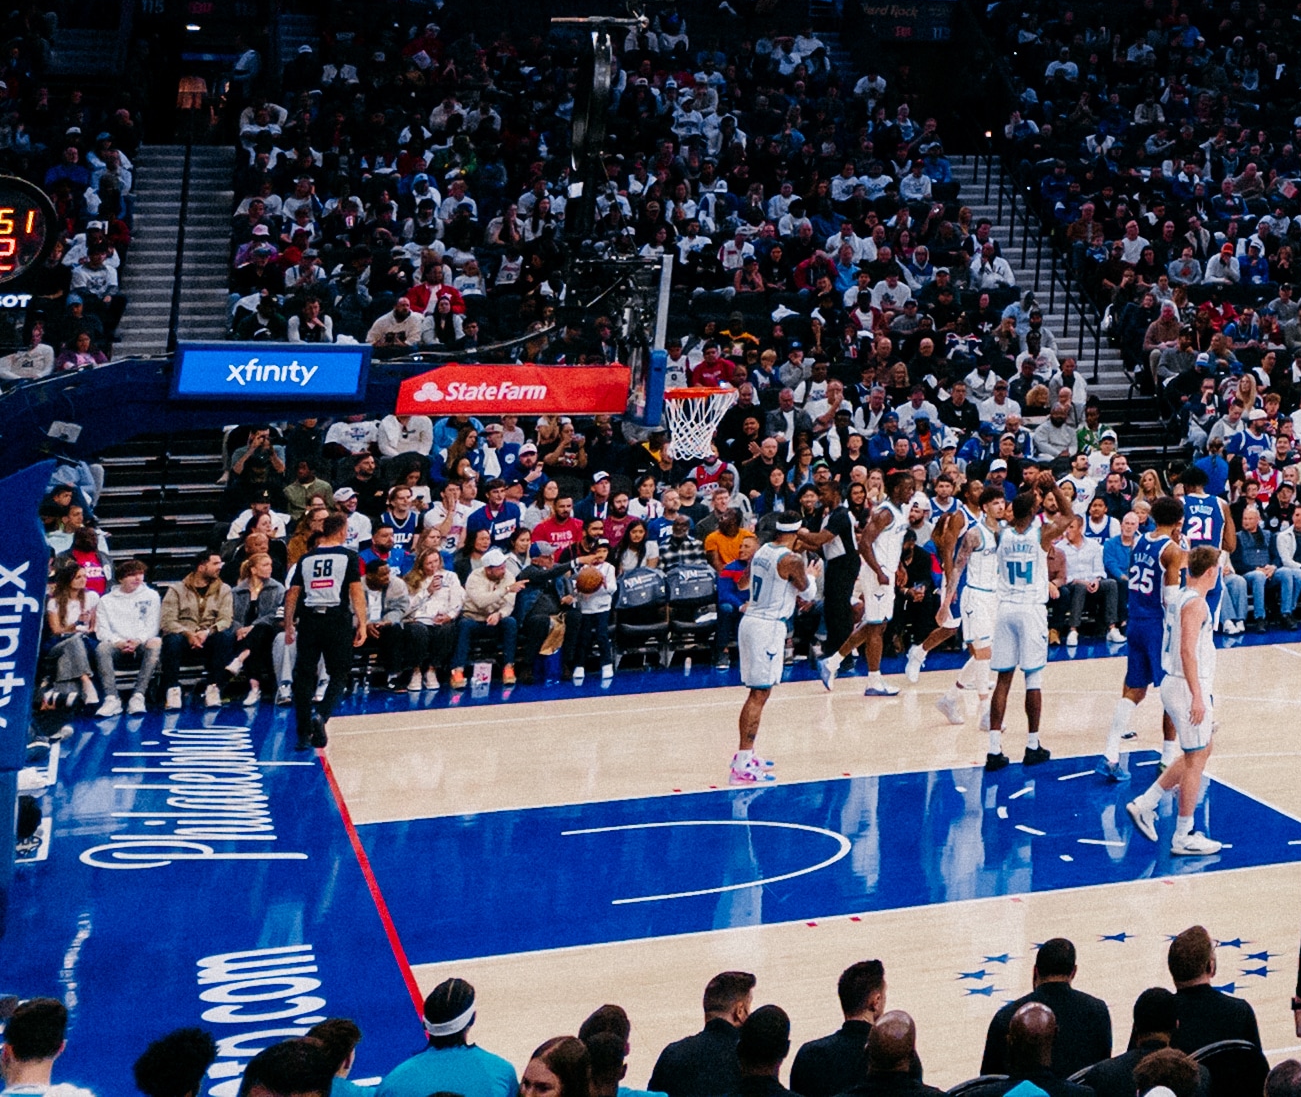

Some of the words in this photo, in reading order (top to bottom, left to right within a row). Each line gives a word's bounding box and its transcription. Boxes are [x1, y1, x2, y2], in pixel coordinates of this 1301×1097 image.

[226, 358, 319, 387] xfinity
[1187, 516, 1213, 540] 21
[313, 559, 333, 578] 58
[1007, 561, 1033, 585] 14
[1128, 565, 1155, 597] 25
[79, 722, 315, 869] Philadelphia
